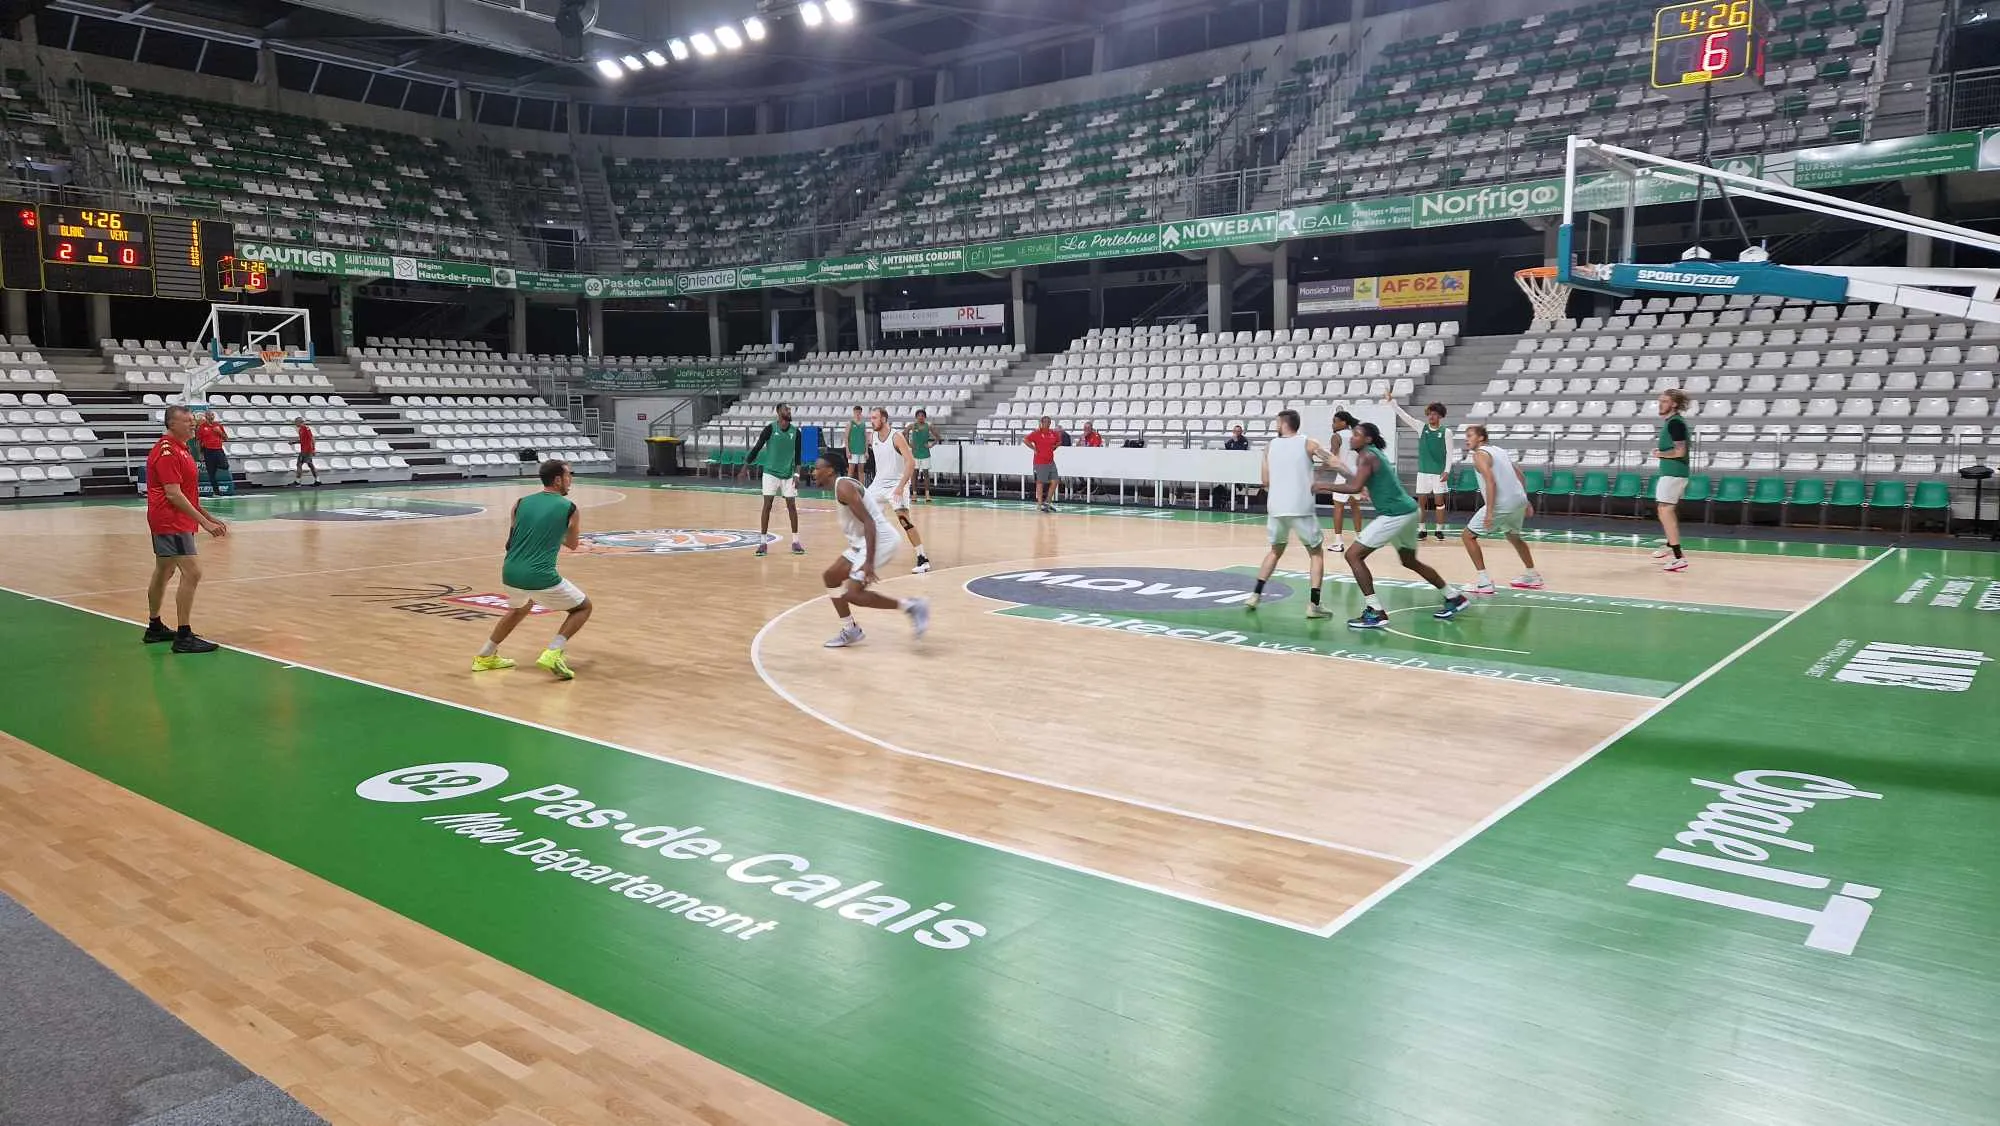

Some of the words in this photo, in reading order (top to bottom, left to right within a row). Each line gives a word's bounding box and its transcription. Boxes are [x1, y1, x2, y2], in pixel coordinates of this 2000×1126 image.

[1680, 0, 1748, 32] 4:26
[1702, 31, 1728, 72] 6
[81, 211, 121, 229] 4:26
[1182, 215, 1275, 239] NOVEBAT
[61, 225, 85, 238] BLANC
[110, 230, 129, 241] VERT
[1060, 236, 1088, 251] La
[1091, 231, 1156, 248] Porteloise
[60, 243, 72, 259] 2
[123, 248, 134, 264] 0
[241, 244, 337, 268] GAUTIER
[882, 253, 924, 265] ANTENNES
[926, 250, 962, 262] CORDIER
[240, 260, 265, 272] 4:26
[417, 262, 442, 271] Région
[250, 272, 261, 287] 6
[418, 270, 492, 284] Hauts-de-France
[680, 271, 735, 289] entendre
[1382, 279, 1408, 294] AF
[1414, 276, 1438, 291] 62
[1299, 287, 1330, 296] Monsieur
[957, 307, 985, 321] PRL
[1258, 640, 1316, 654] we
[1329, 648, 1430, 670] tech
[1447, 662, 1574, 687] care.
[421, 812, 524, 845] Mon
[505, 838, 777, 942] Département
